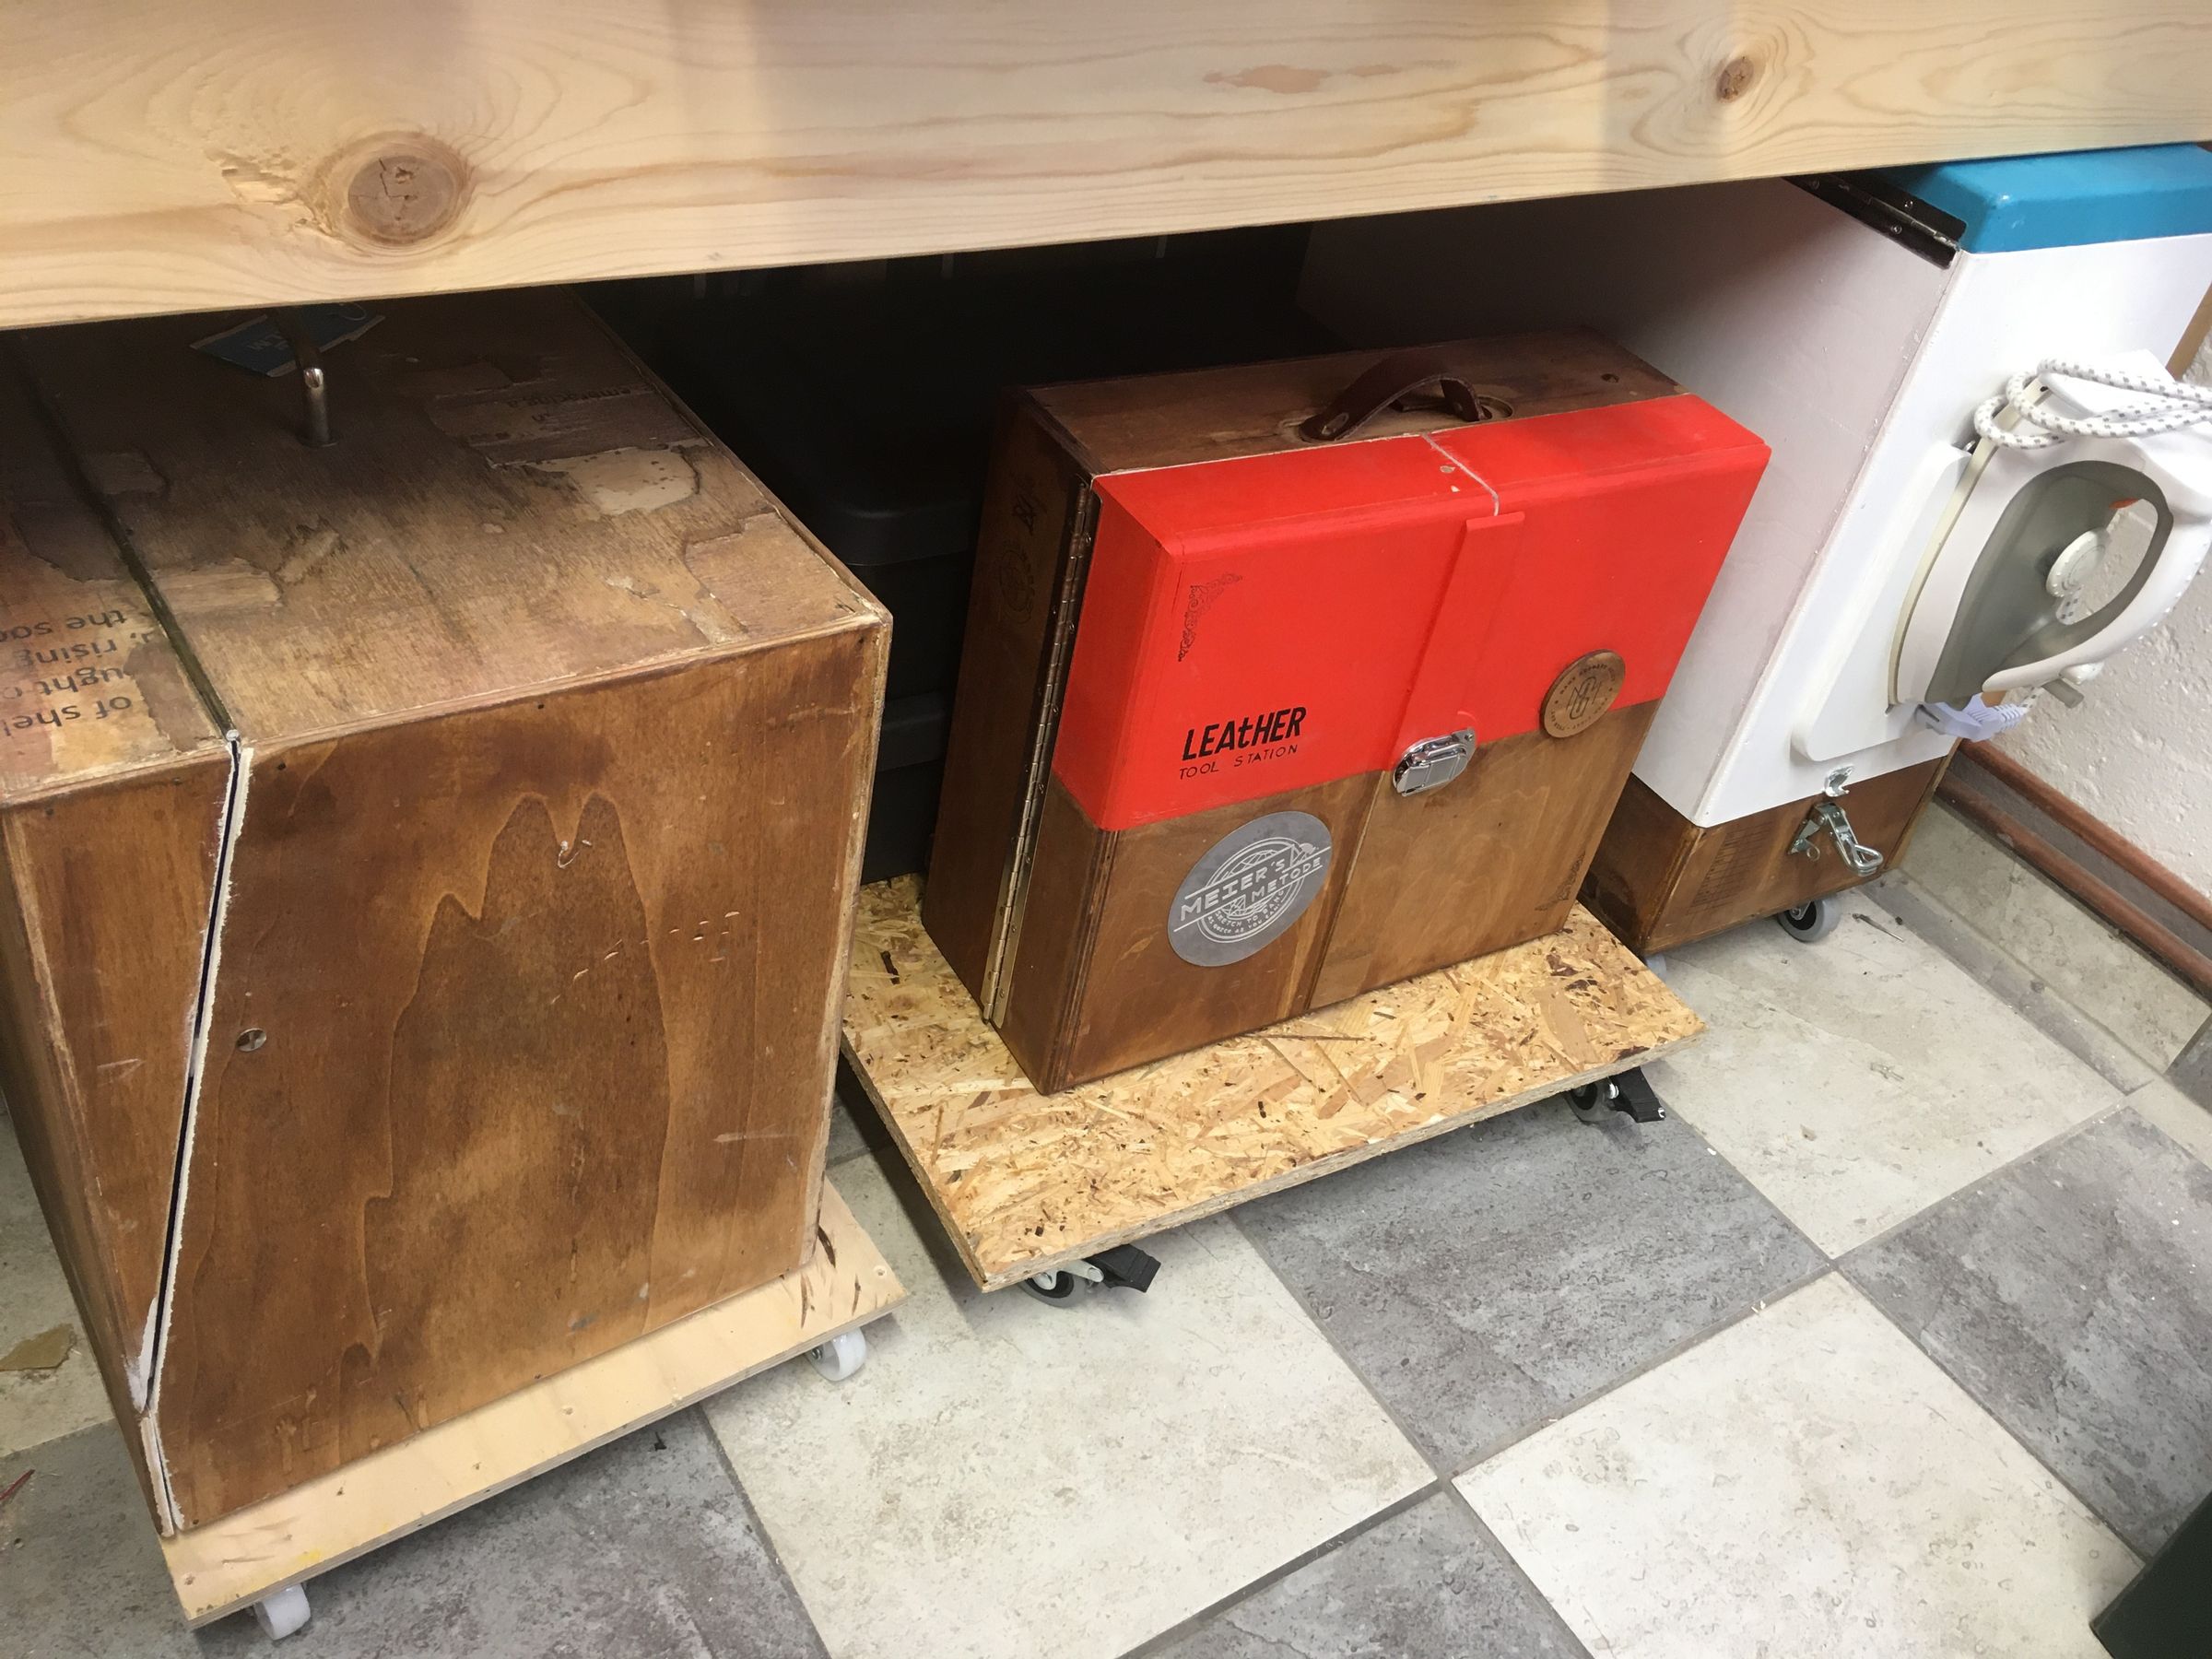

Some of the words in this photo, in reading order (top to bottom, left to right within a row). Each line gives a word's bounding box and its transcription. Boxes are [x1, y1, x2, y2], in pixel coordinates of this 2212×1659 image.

[65, 609, 127, 629] the
[95, 696, 132, 720] of
[1179, 761, 1219, 780] TOOL
[1233, 744, 1298, 768] STATION
[1180, 858, 1286, 922] MEIER'S
[1251, 856, 1322, 903] METODE
